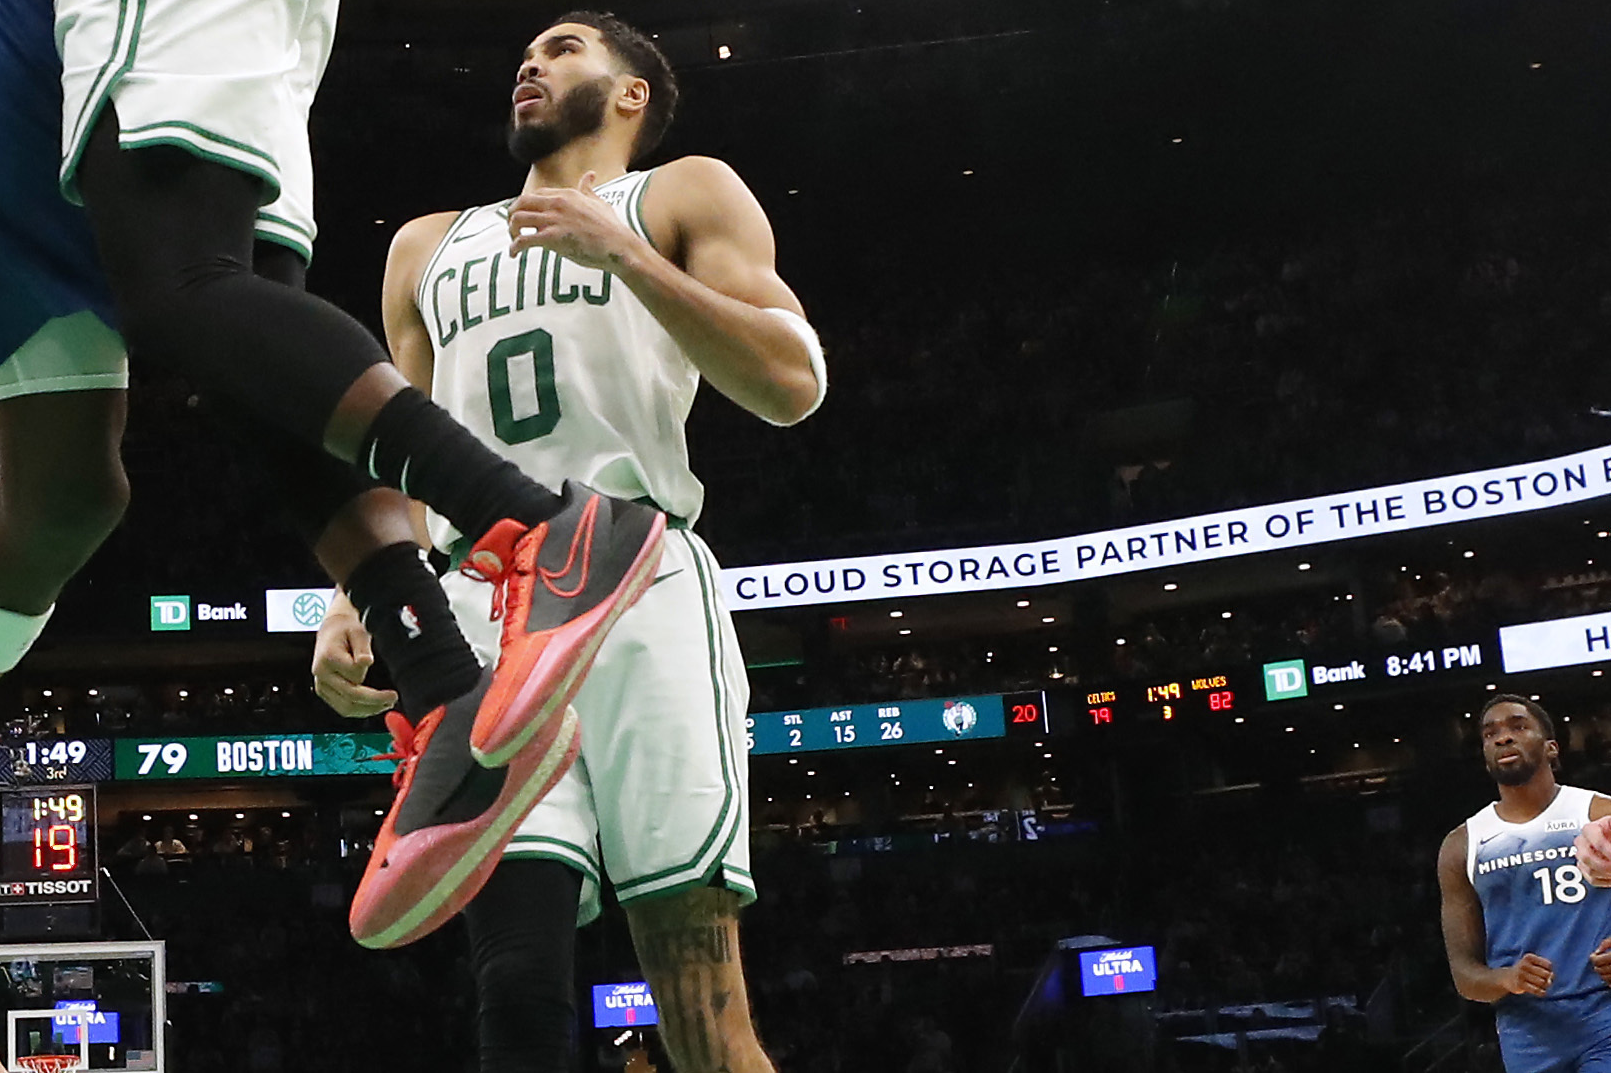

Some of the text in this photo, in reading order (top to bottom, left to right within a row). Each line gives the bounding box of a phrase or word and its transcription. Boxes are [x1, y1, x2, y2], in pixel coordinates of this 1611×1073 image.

[487, 327, 562, 446] 0
[736, 568, 866, 601] CLOUD
[883, 550, 1061, 587] STORAGE
[1076, 520, 1250, 569] PARTNER
[1264, 509, 1315, 538] OF
[1330, 495, 1405, 531] THE
[1423, 463, 1587, 516] BOSTON
[154, 601, 247, 624] TD Bank
[1386, 644, 1482, 676] 8:41 PM
[1191, 676, 1227, 690] WOLVES
[1267, 661, 1366, 692] TD Bank
[1087, 691, 1116, 704] CELTICS
[1148, 683, 1180, 702] 1:49
[1210, 691, 1233, 710] 82
[784, 714, 803, 725] STL
[830, 711, 852, 722] AST
[878, 707, 900, 718] REB
[1012, 704, 1038, 723] 20
[1089, 708, 1112, 724] 79
[1163, 706, 1172, 719] 3
[789, 729, 802, 747] 2
[834, 725, 855, 743] 15
[880, 723, 903, 740] 26
[25, 741, 87, 765] 1:49
[137, 739, 313, 775] 79 BOSTON
[46, 766, 68, 779] 3rd
[32, 794, 84, 821] 1:49
[35, 825, 77, 870] 19
[1478, 845, 1577, 875] MINNESOTA
[25, 880, 91, 895] TISSOT
[1533, 865, 1587, 905] 18
[1092, 959, 1144, 976] ULTRA
[605, 993, 654, 1008] ULTRA
